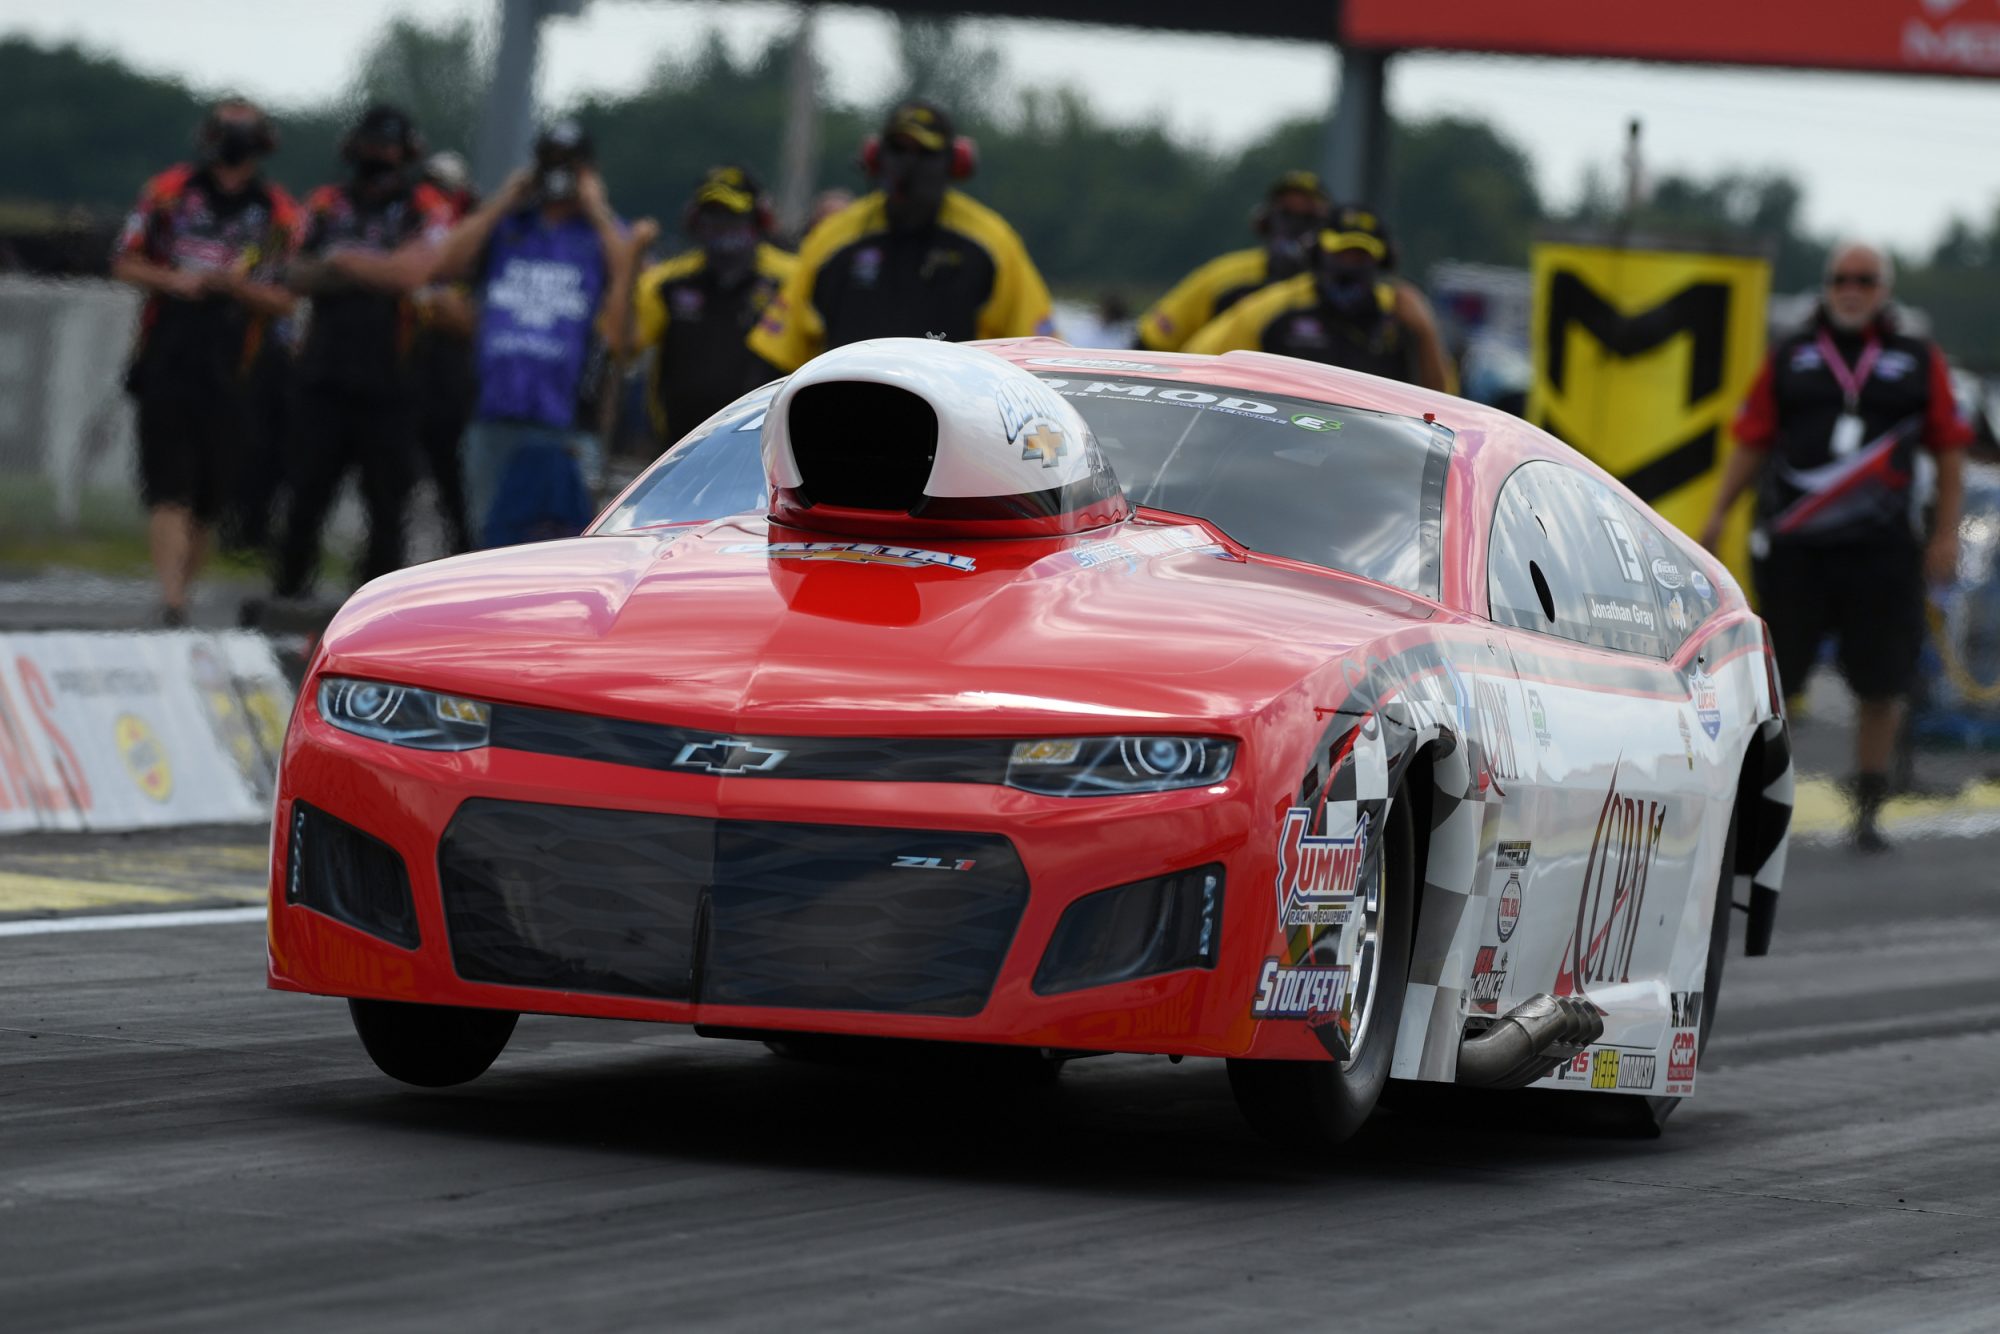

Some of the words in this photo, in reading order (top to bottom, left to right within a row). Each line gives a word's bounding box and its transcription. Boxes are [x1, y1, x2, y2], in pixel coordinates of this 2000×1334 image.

[1084, 382, 1277, 415] MOD
[1591, 598, 1632, 622] Jonathan
[1632, 603, 1655, 632] Gray
[1288, 910, 1317, 923] RACING
[1255, 960, 1350, 1012] STOCKSETH
[1619, 1054, 1656, 1090] MOROSO
